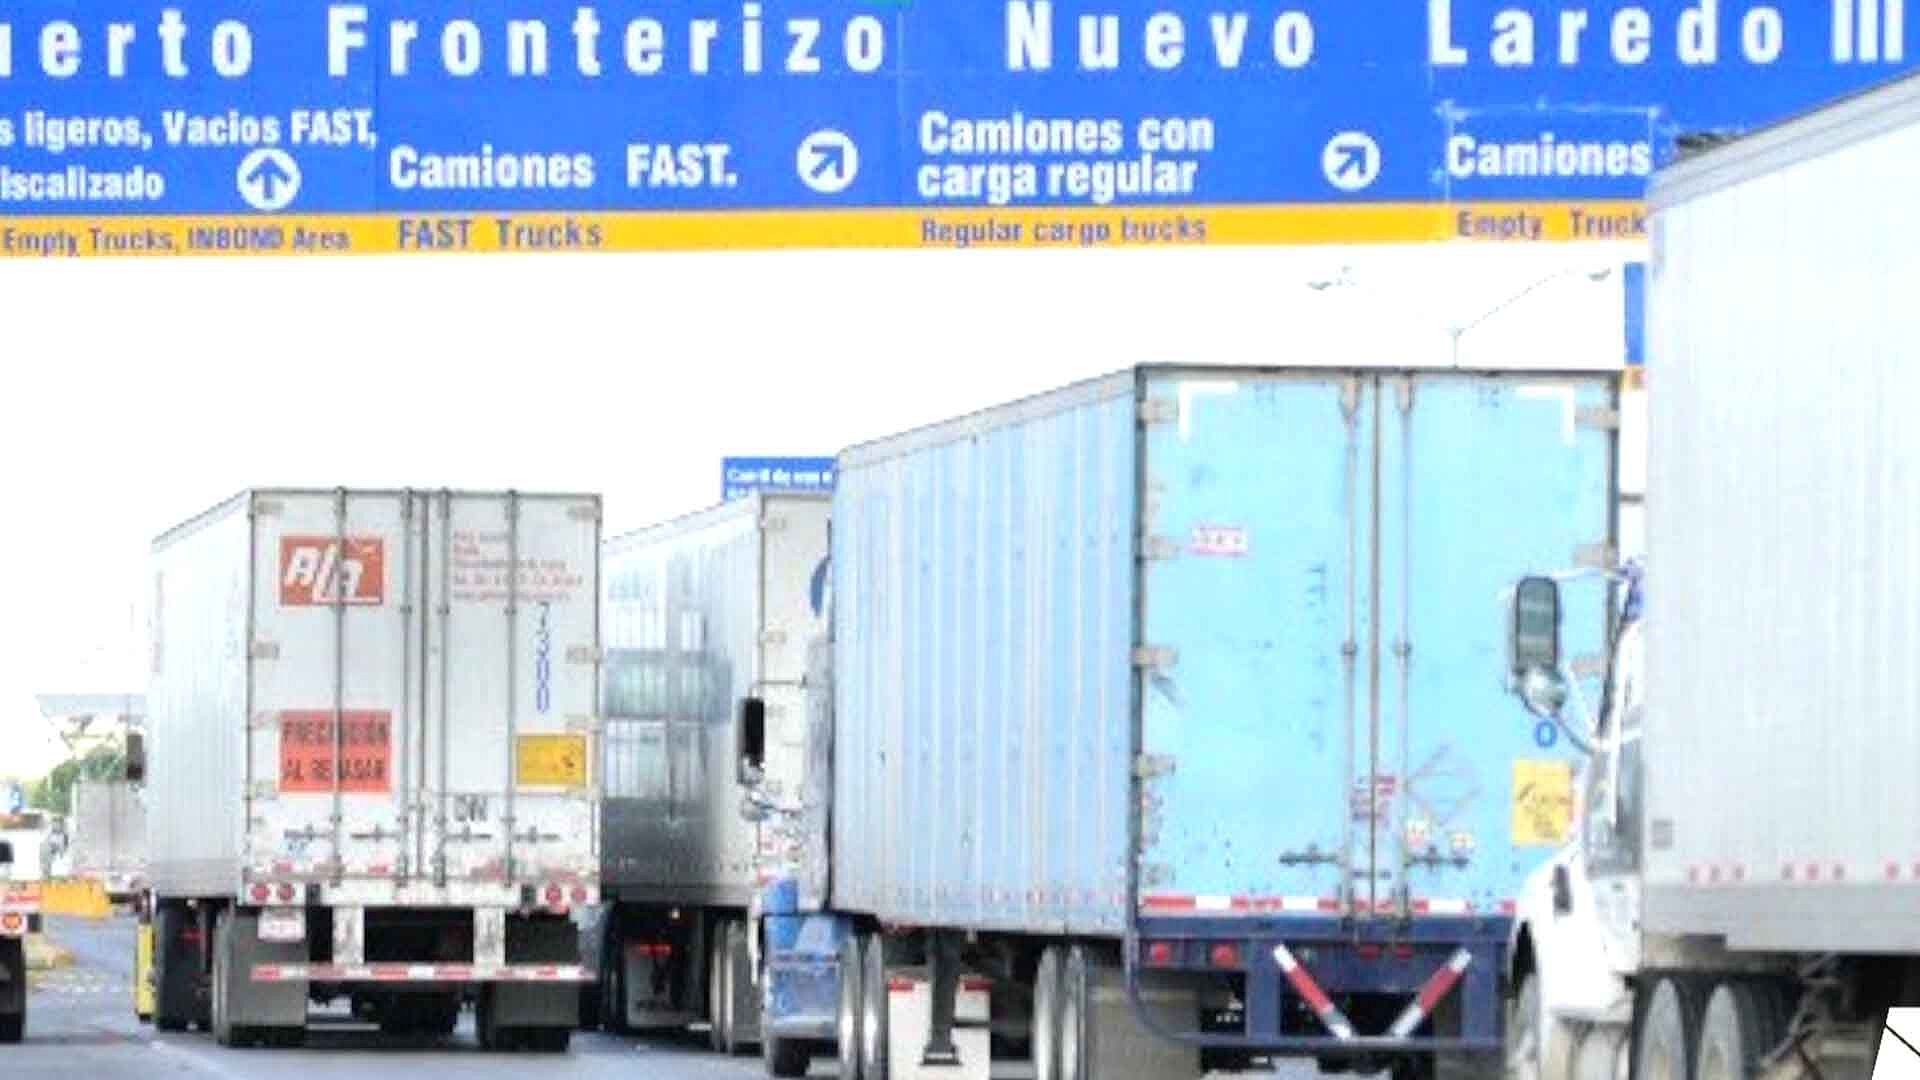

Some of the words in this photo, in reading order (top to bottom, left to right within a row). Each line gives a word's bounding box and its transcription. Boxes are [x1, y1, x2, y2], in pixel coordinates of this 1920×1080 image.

[327, 4, 885, 78] Fronterizo
[1006, 0, 1315, 68] Nuevo
[1430, 0, 1783, 66] Laredo
[24, 111, 153, 152] ligeros,
[162, 110, 280, 147] Vacios
[290, 109, 377, 149] FAST,
[919, 109, 1124, 154] Camiones
[1137, 117, 1215, 151] con
[389, 145, 595, 190] Camiones
[626, 144, 737, 188] FAST.
[1447, 132, 1651, 178] Camiones
[918, 164, 1036, 205] carga
[1049, 154, 1198, 203] regular
[3, 228, 79, 258] Empty
[89, 228, 180, 255] Trucks,
[293, 227, 349, 251] Area
[397, 220, 471, 249] FAST
[496, 219, 603, 249] Trucks
[921, 217, 1024, 248] Regular
[1033, 219, 1111, 249] cargo
[1120, 216, 1207, 244] trucks
[1456, 210, 1543, 242] Empty
